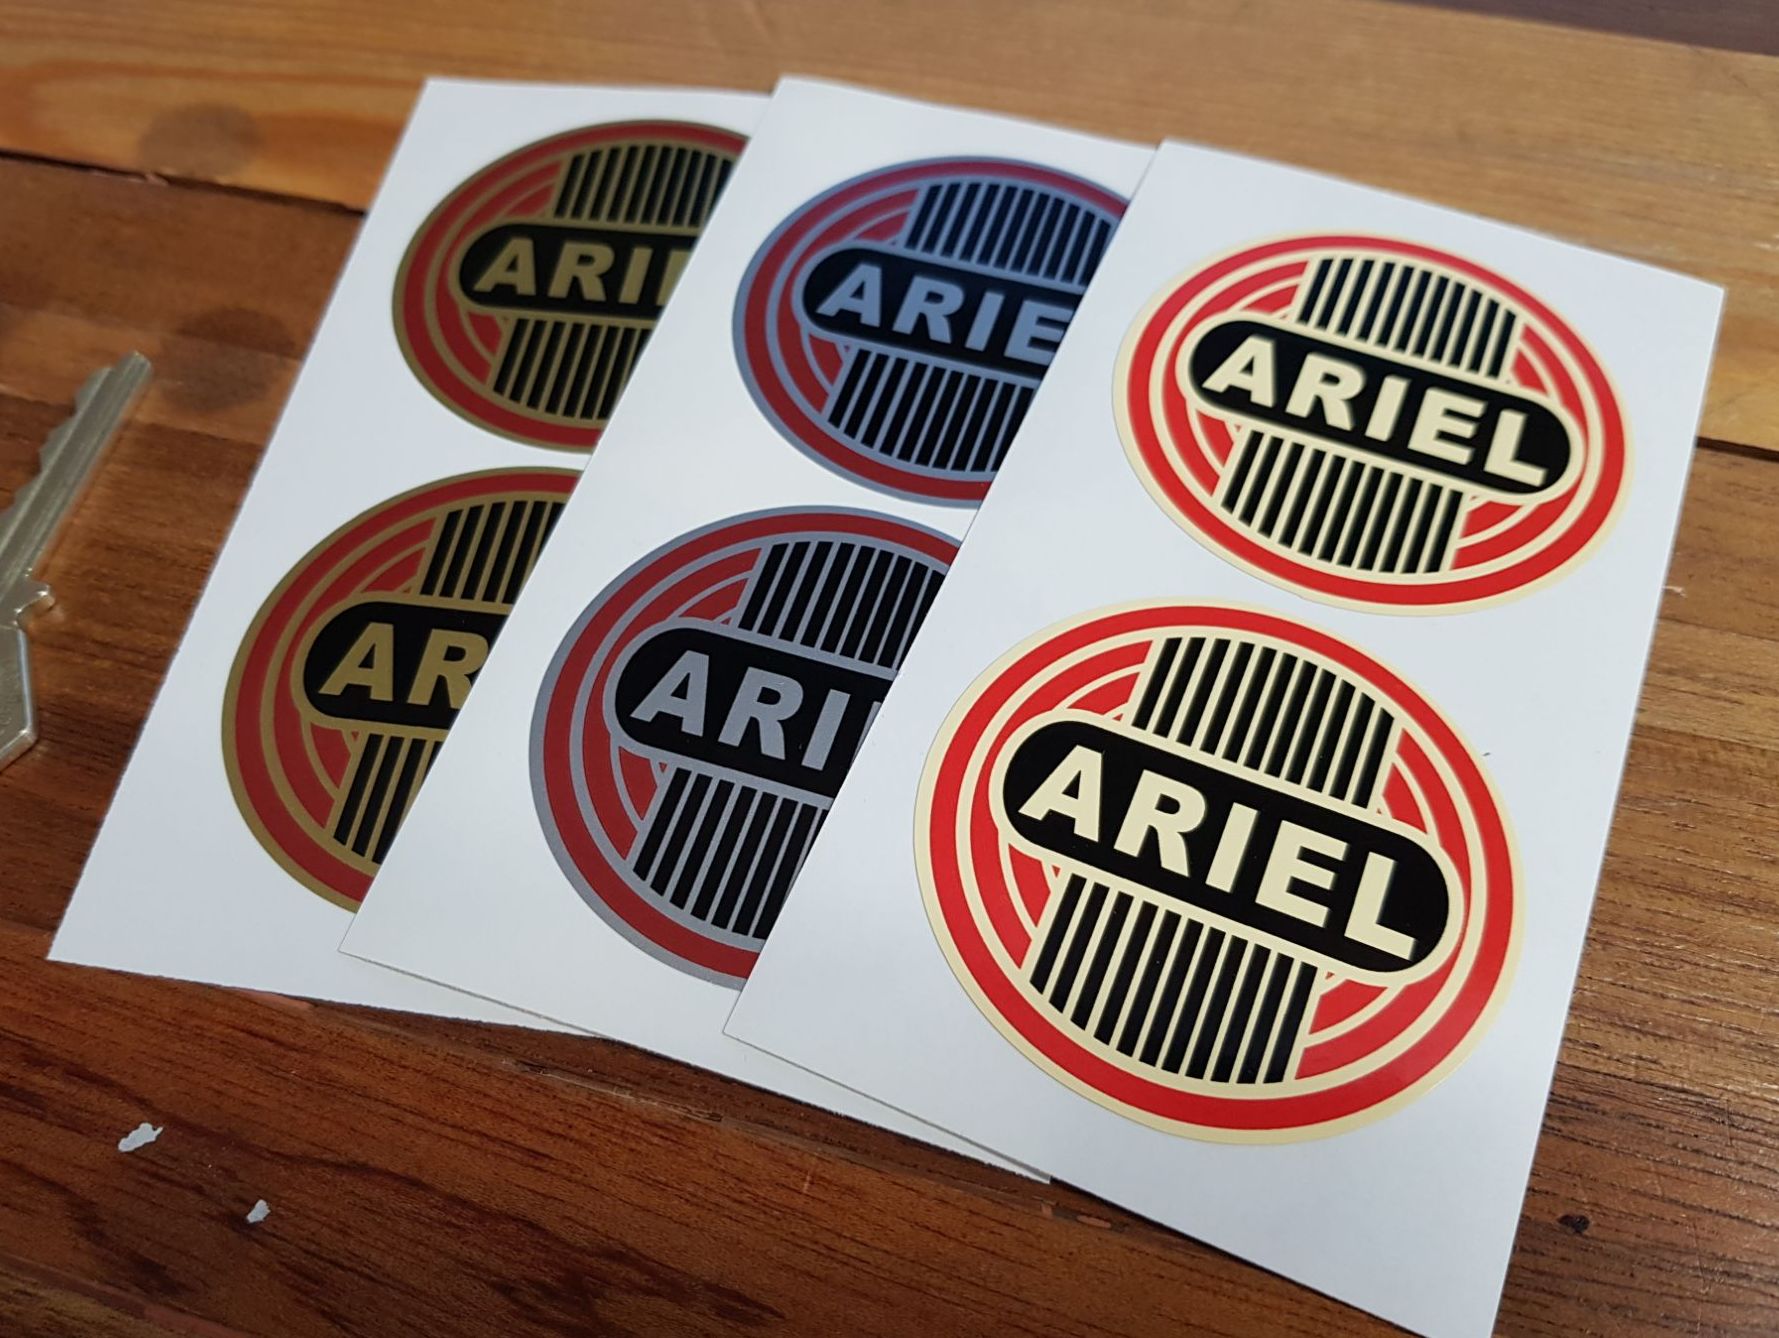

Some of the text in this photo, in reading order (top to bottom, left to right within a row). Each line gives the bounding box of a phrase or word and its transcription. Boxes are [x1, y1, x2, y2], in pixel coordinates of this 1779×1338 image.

[815, 261, 1077, 366] ARIE
[1201, 334, 1548, 487] ARIEL
[317, 621, 490, 710] AR
[629, 649, 883, 771] ARI
[1017, 744, 1418, 962] ARIEL
